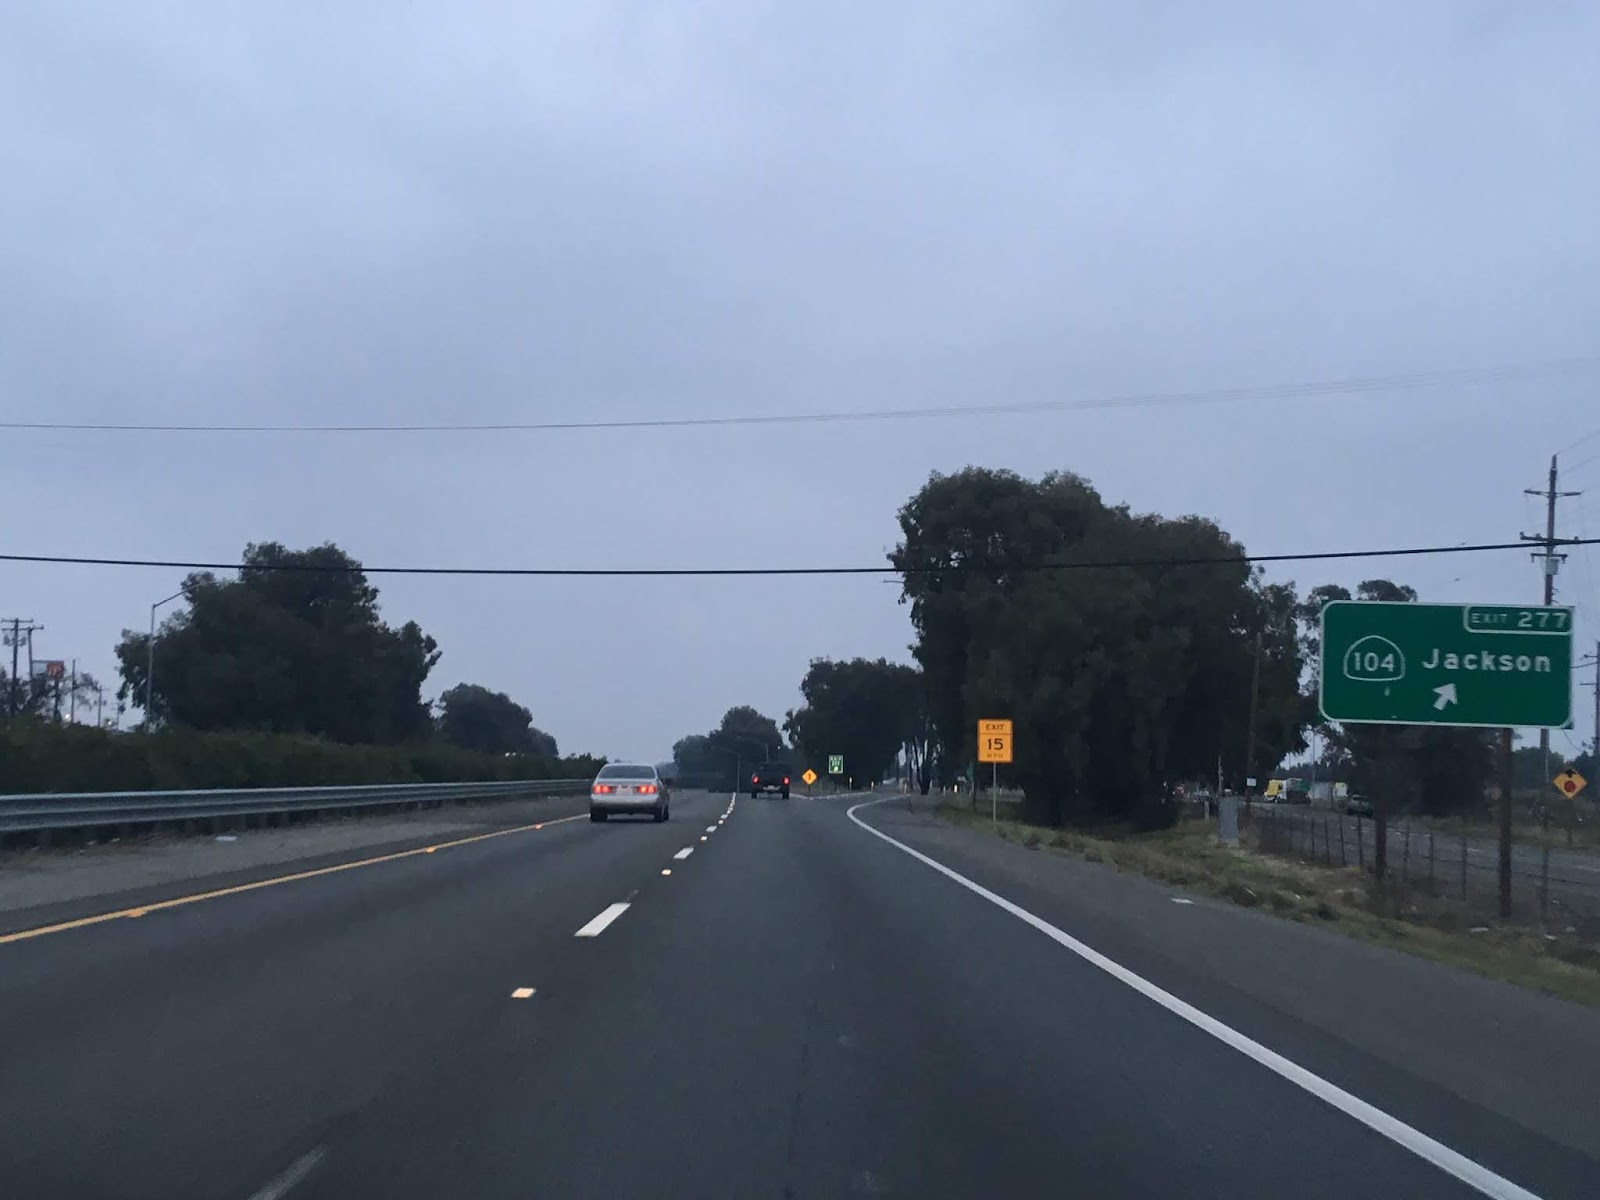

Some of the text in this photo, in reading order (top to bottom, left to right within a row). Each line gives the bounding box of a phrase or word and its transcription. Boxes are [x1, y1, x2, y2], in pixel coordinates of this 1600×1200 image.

[1471, 611, 1567, 628] EXIT 277
[1353, 652, 1395, 672] 104
[1421, 648, 1551, 673] Jackson
[987, 738, 1004, 750] 15
